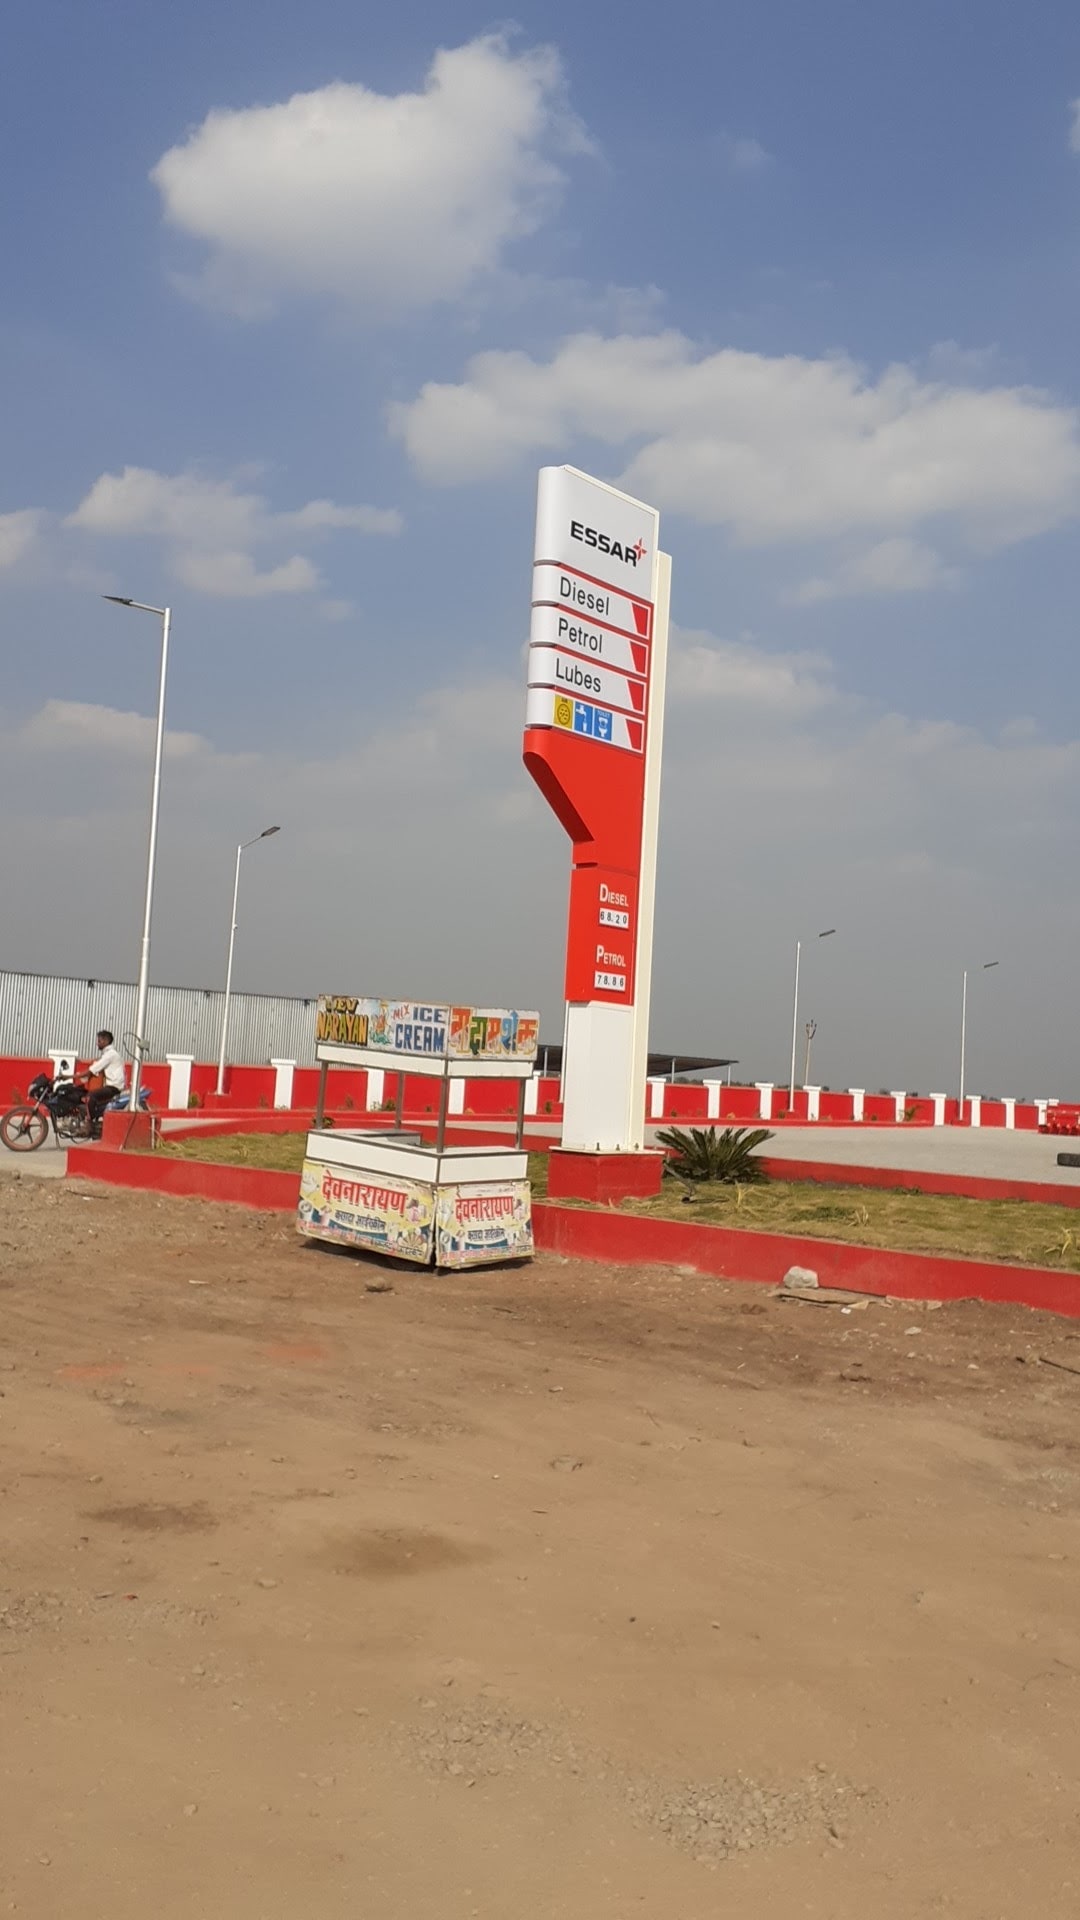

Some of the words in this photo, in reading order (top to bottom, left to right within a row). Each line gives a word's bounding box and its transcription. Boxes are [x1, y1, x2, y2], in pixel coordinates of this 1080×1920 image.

[571, 520, 637, 567] ESSAR
[560, 577, 609, 616] Diesel
[558, 617, 603, 653] Petrol
[555, 658, 602, 693] Lubes
[600, 911, 627, 925] 68.20
[597, 974, 624, 987] 78.86
[317, 1010, 369, 1047] NARAYAN
[392, 1004, 410, 1020] MIX
[413, 1007, 448, 1024] ICE
[394, 1024, 445, 1053] CREAM
[321, 1169, 408, 1217] देवनारायण
[455, 1192, 514, 1225] देवनारायण
